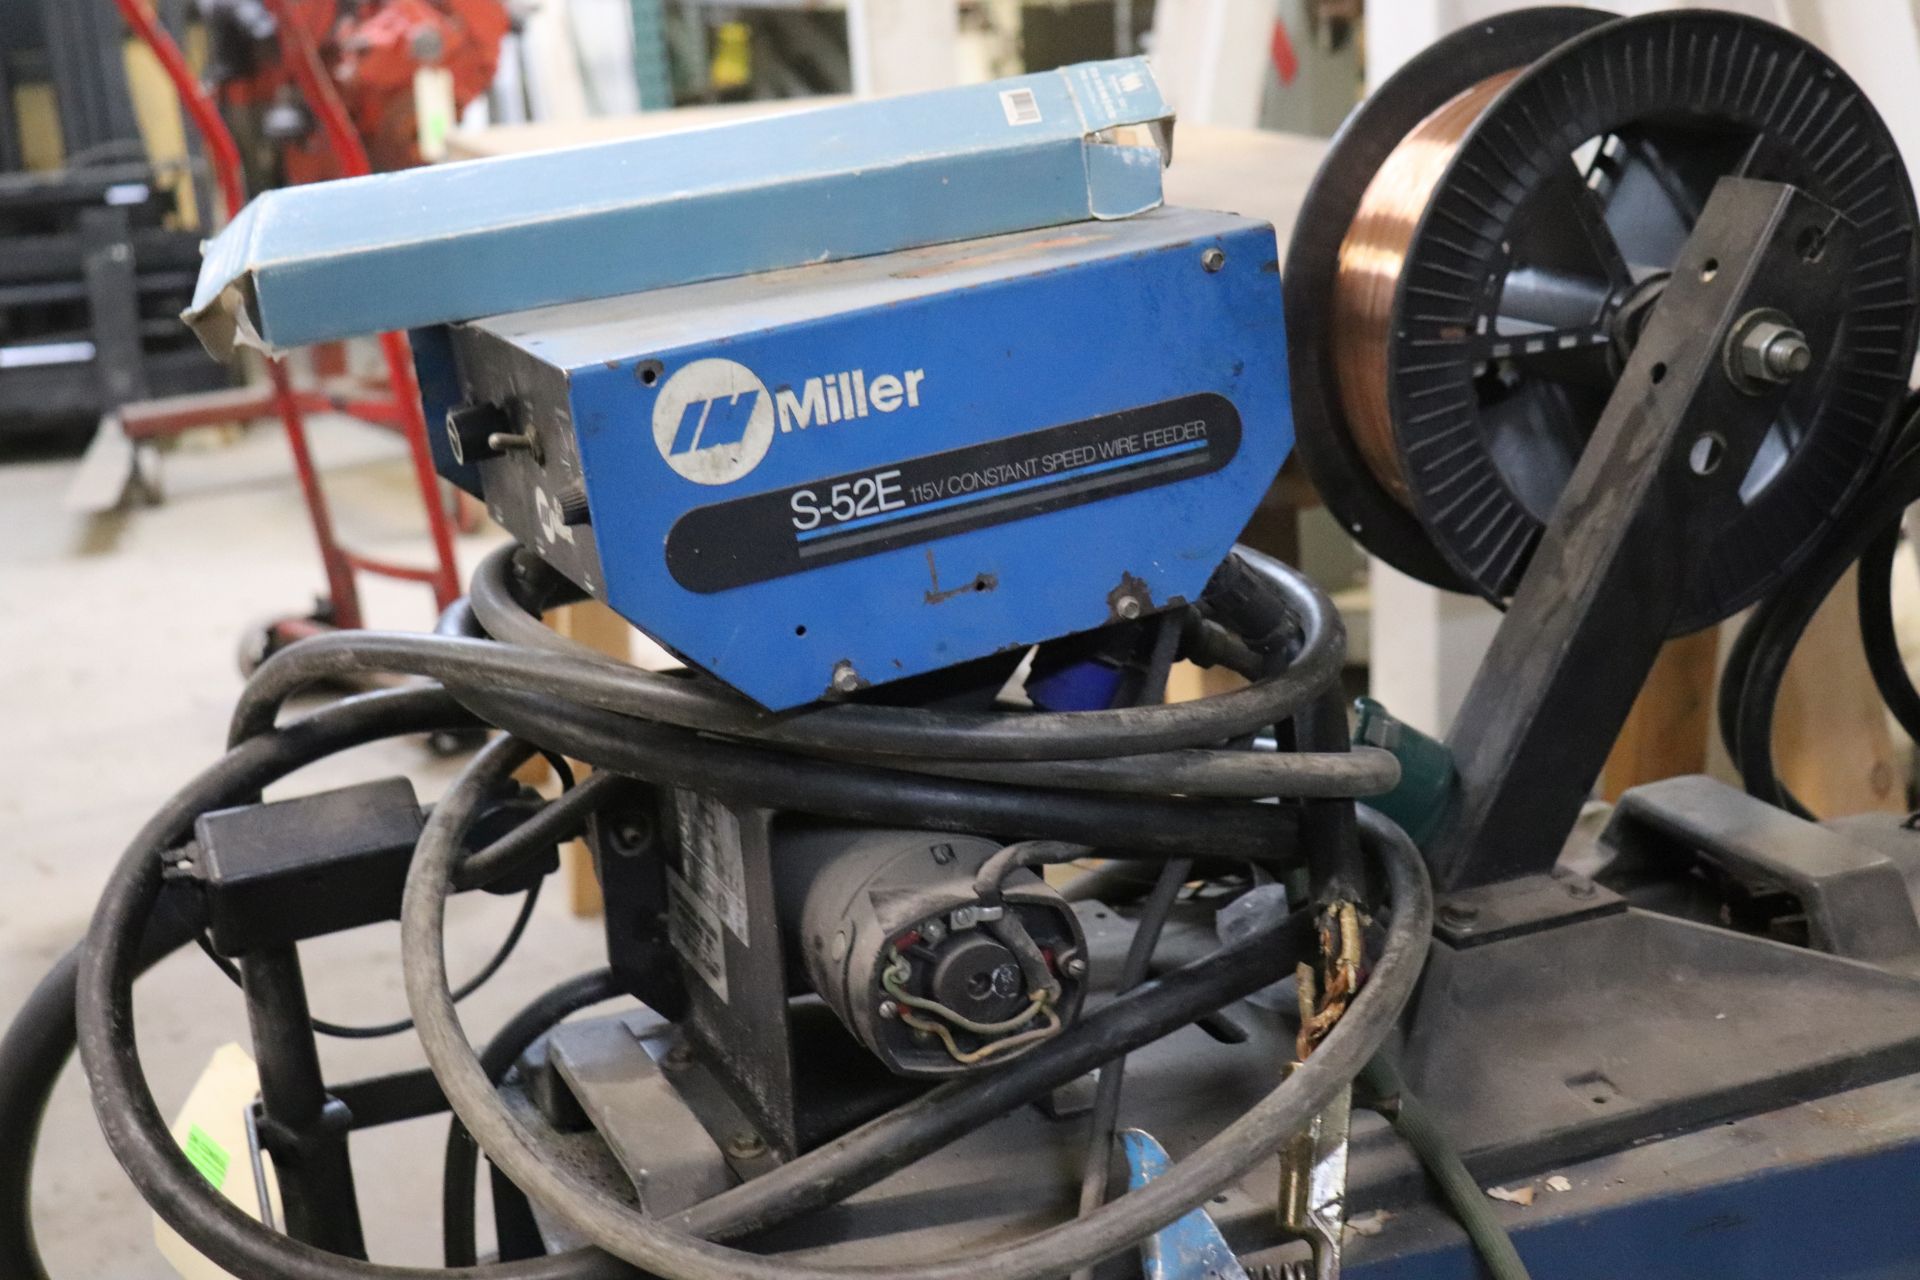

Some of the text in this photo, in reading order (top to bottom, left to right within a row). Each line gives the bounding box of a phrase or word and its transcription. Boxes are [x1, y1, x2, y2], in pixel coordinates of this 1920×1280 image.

[775, 368, 925, 433] Miller
[790, 420, 1207, 530] S-52E 115V CONSTANT SPEED WIRE FEEDER
